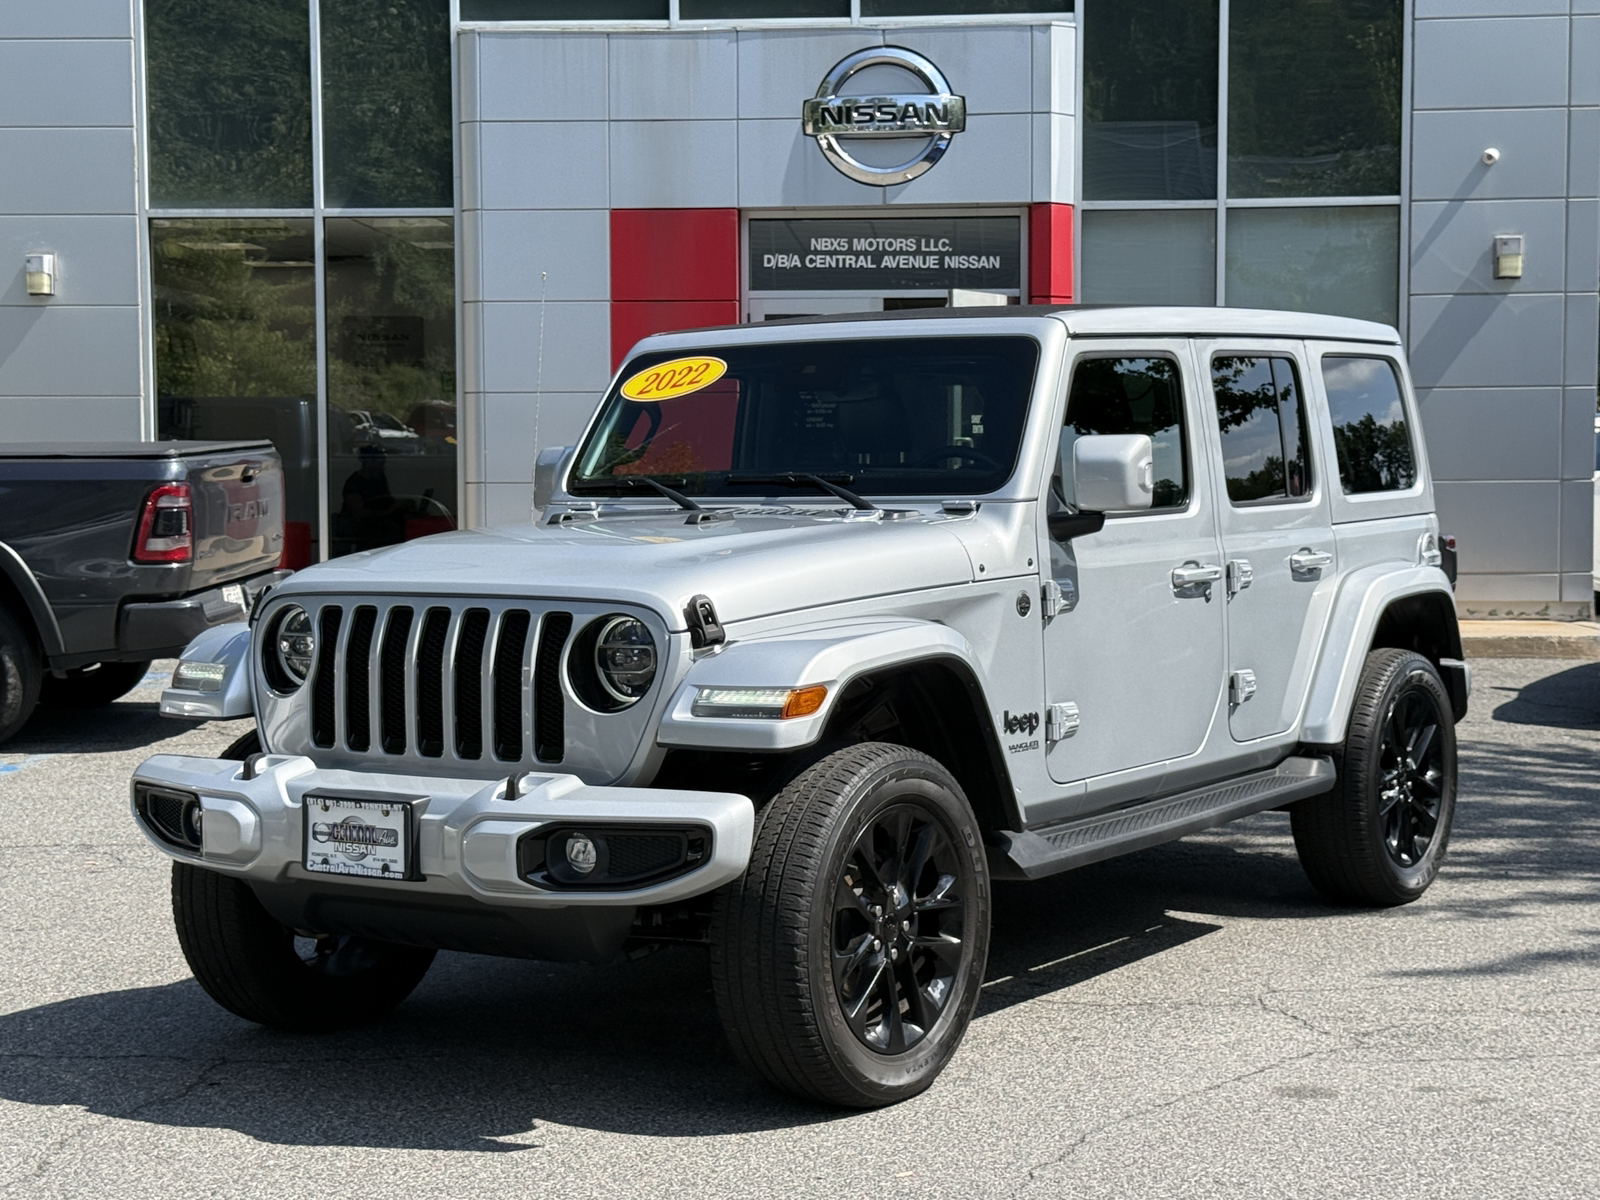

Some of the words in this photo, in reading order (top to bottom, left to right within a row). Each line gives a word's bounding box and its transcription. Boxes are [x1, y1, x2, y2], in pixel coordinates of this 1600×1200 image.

[819, 101, 950, 128] NISSAN
[852, 237, 916, 251] MOTORS
[921, 238, 953, 252] LLC.
[763, 254, 802, 269] D/B/A
[805, 254, 877, 269] CENTRAL
[880, 254, 940, 269] AVENUE
[944, 254, 1000, 269] NISSAN
[357, 333, 410, 341] NISSAN
[636, 363, 710, 396] 2022
[228, 498, 271, 524] RAM
[1003, 710, 1039, 736] Jeep
[334, 842, 376, 855] NISSAN
[307, 860, 403, 879] CentralAveNissan.com
